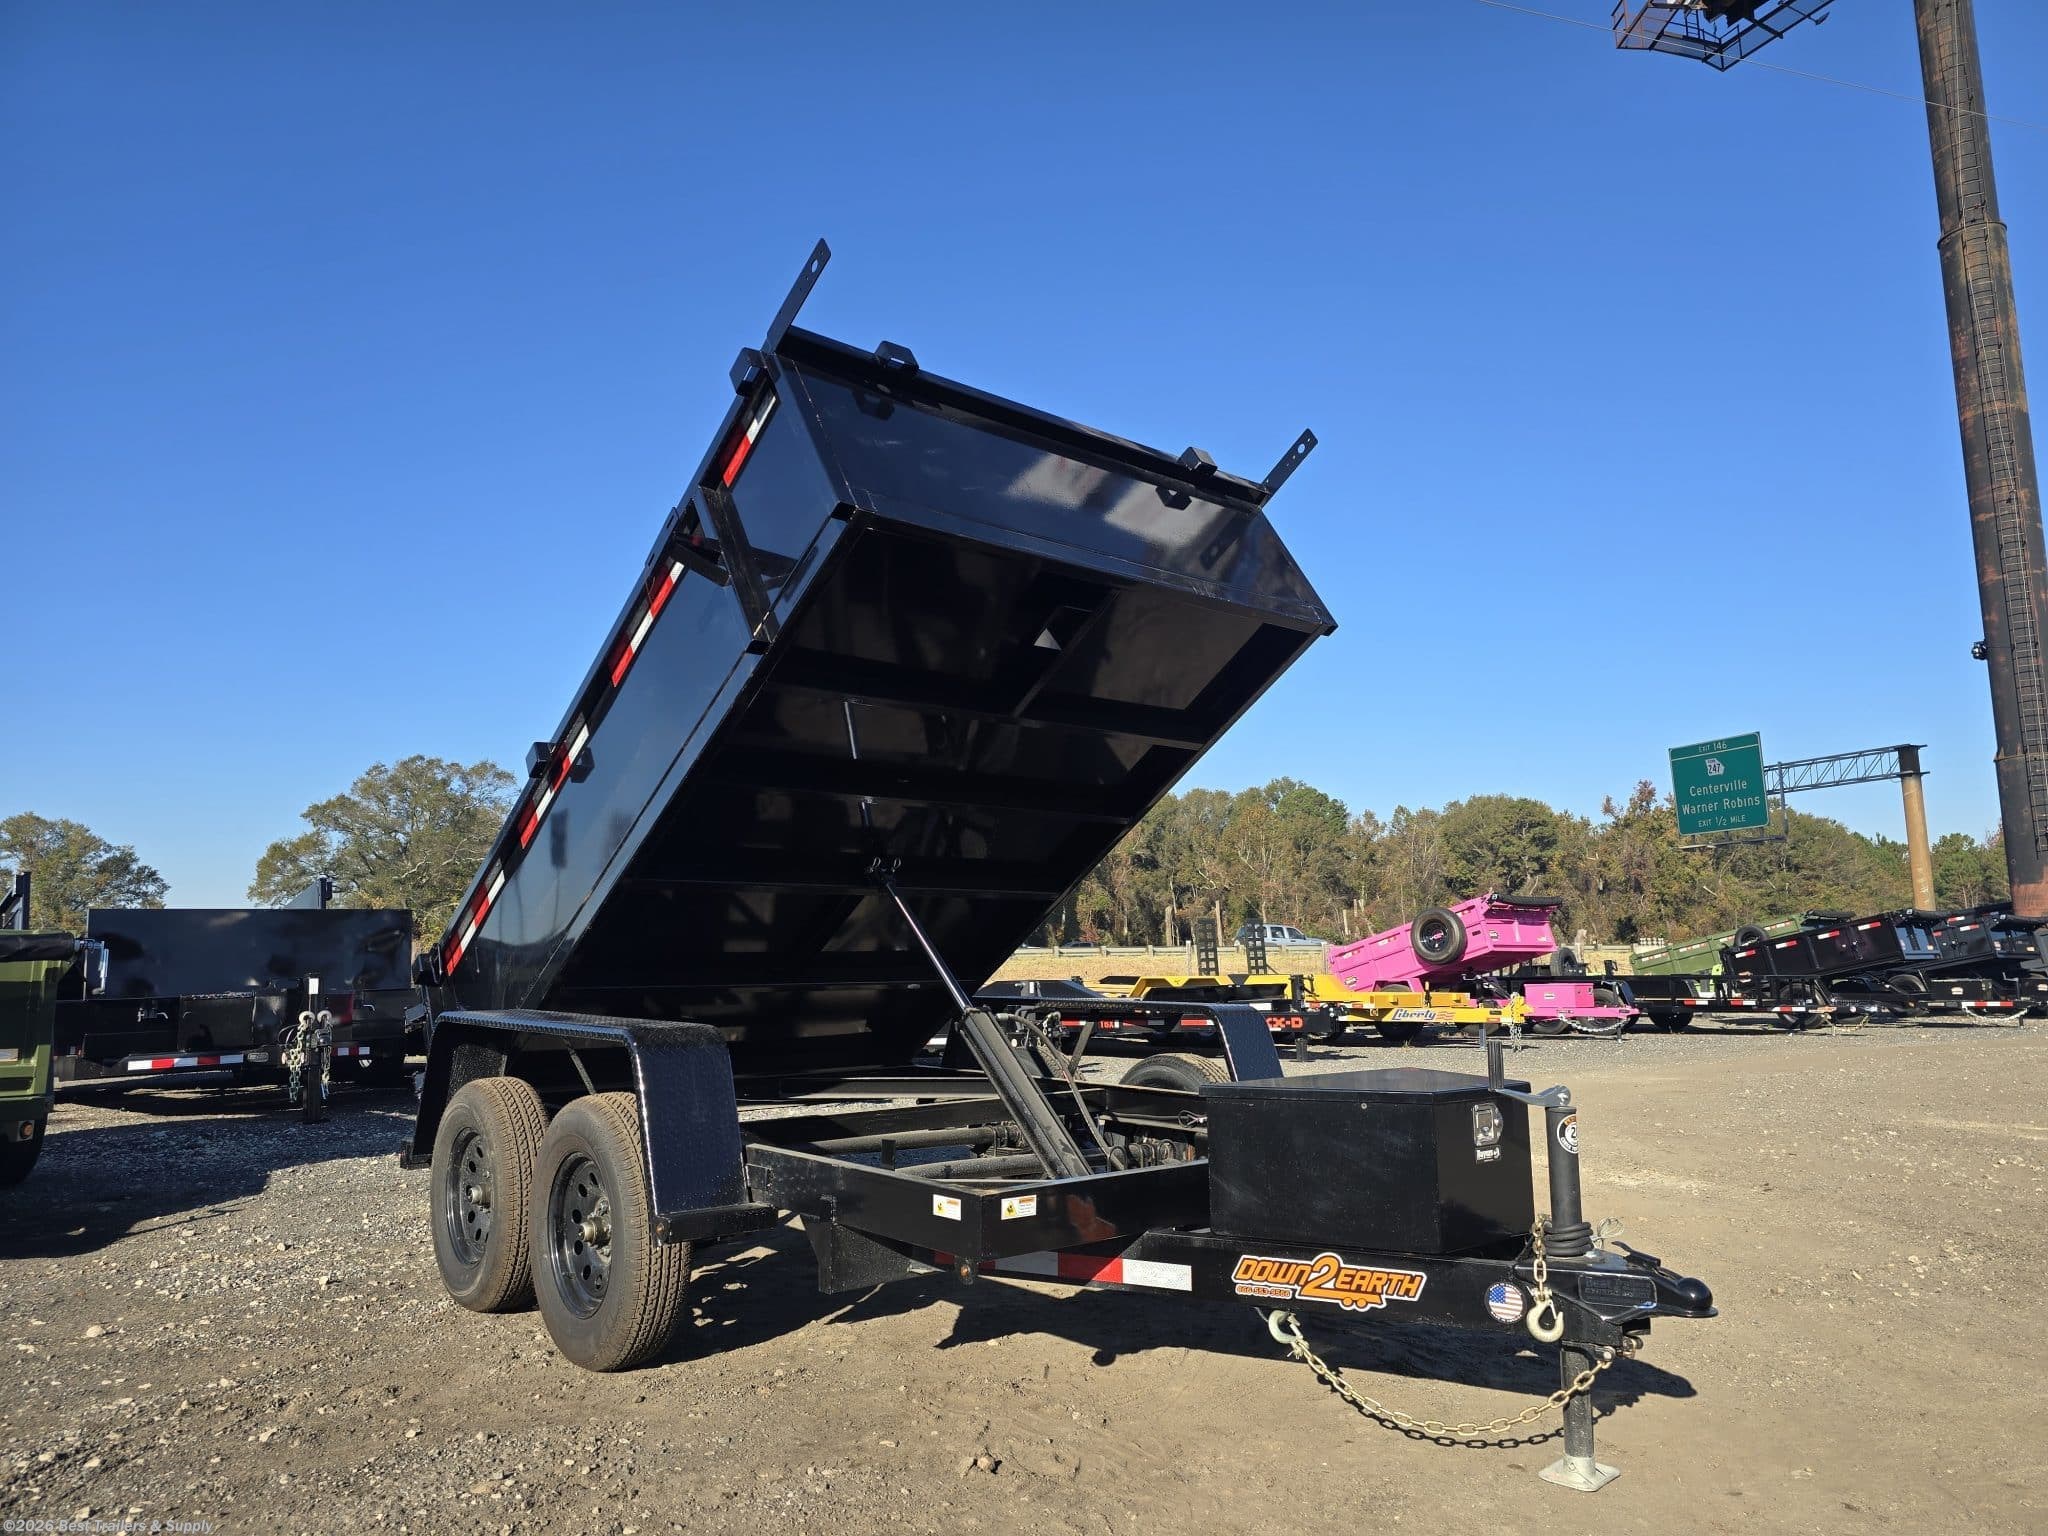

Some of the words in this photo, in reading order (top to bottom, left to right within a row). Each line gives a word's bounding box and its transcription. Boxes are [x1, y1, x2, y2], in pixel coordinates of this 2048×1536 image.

[1713, 741, 1728, 751] 146
[1708, 763, 1721, 774] 247
[1689, 780, 1747, 797] Centerville
[1682, 801, 1718, 815] Warner
[1723, 796, 1760, 810] Robins
[1698, 819, 1712, 827] EXIT
[1730, 814, 1746, 823] MILE
[1392, 1009, 1436, 1021] Liberty
